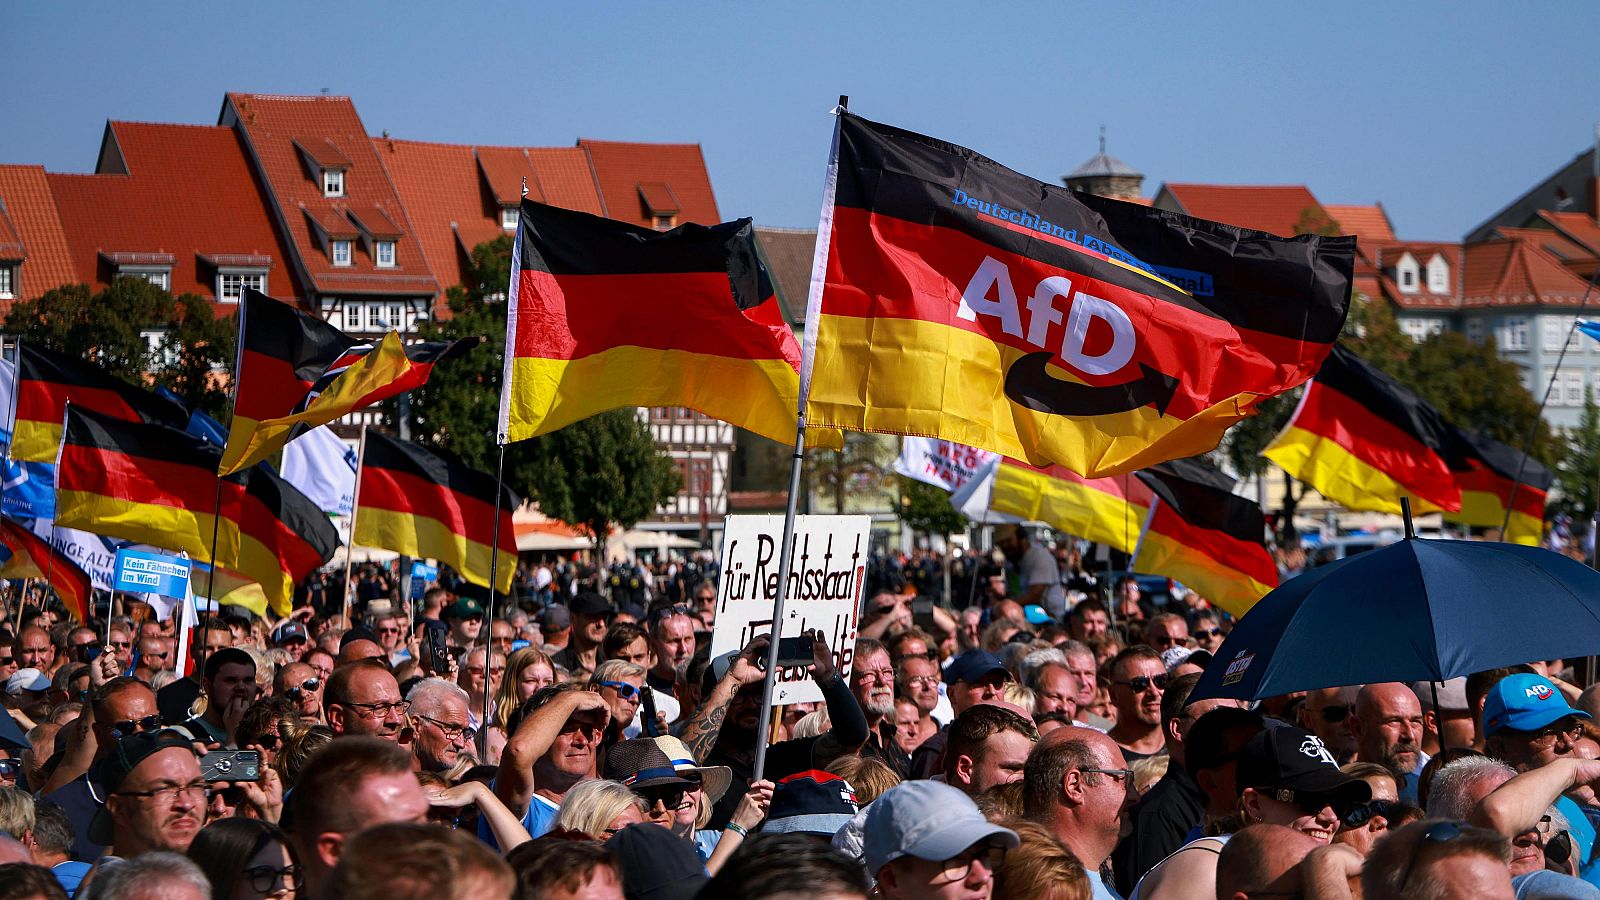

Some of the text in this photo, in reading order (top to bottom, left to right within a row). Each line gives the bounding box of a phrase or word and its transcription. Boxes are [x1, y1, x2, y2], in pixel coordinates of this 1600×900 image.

[952, 188, 1083, 245] Deutschland.
[957, 255, 1136, 376] AfD
[3, 496, 33, 510] ERNATIVE
[86, 551, 115, 569] ALT
[125, 559, 187, 577] Kein Fähnchen
[123, 572, 158, 585] im Wind
[722, 540, 751, 613] für
[1525, 684, 1548, 698] AfD
